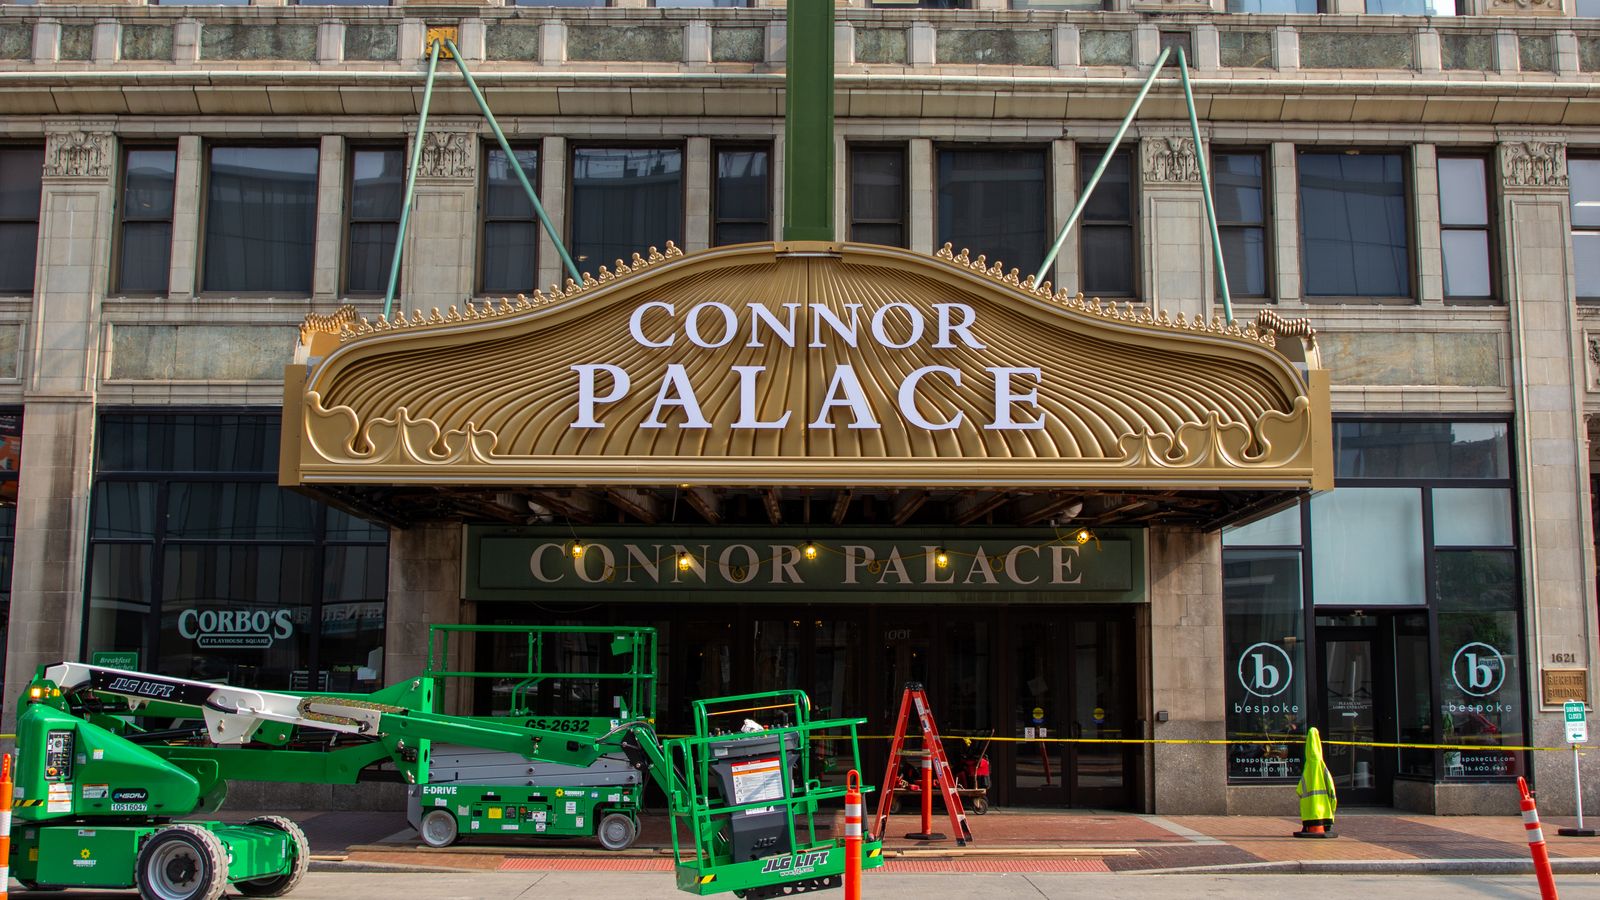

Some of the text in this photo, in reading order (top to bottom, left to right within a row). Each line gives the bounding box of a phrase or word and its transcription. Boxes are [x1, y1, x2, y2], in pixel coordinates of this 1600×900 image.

[628, 301, 987, 350] CONNOR
[569, 363, 1047, 431] PALACE
[530, 543, 1083, 584] CONNOR PALACE
[178, 609, 293, 639] CORBO'S
[99, 657, 131, 665] Breakfast
[1551, 653, 1576, 663] 1621
[108, 677, 175, 698] JLG LIFT
[1234, 702, 1299, 715] bespoke
[1448, 702, 1512, 714] bespoke
[525, 719, 590, 732] GS-2632
[423, 786, 457, 795] E-DRIVE
[761, 850, 829, 873] JLG LIFT
